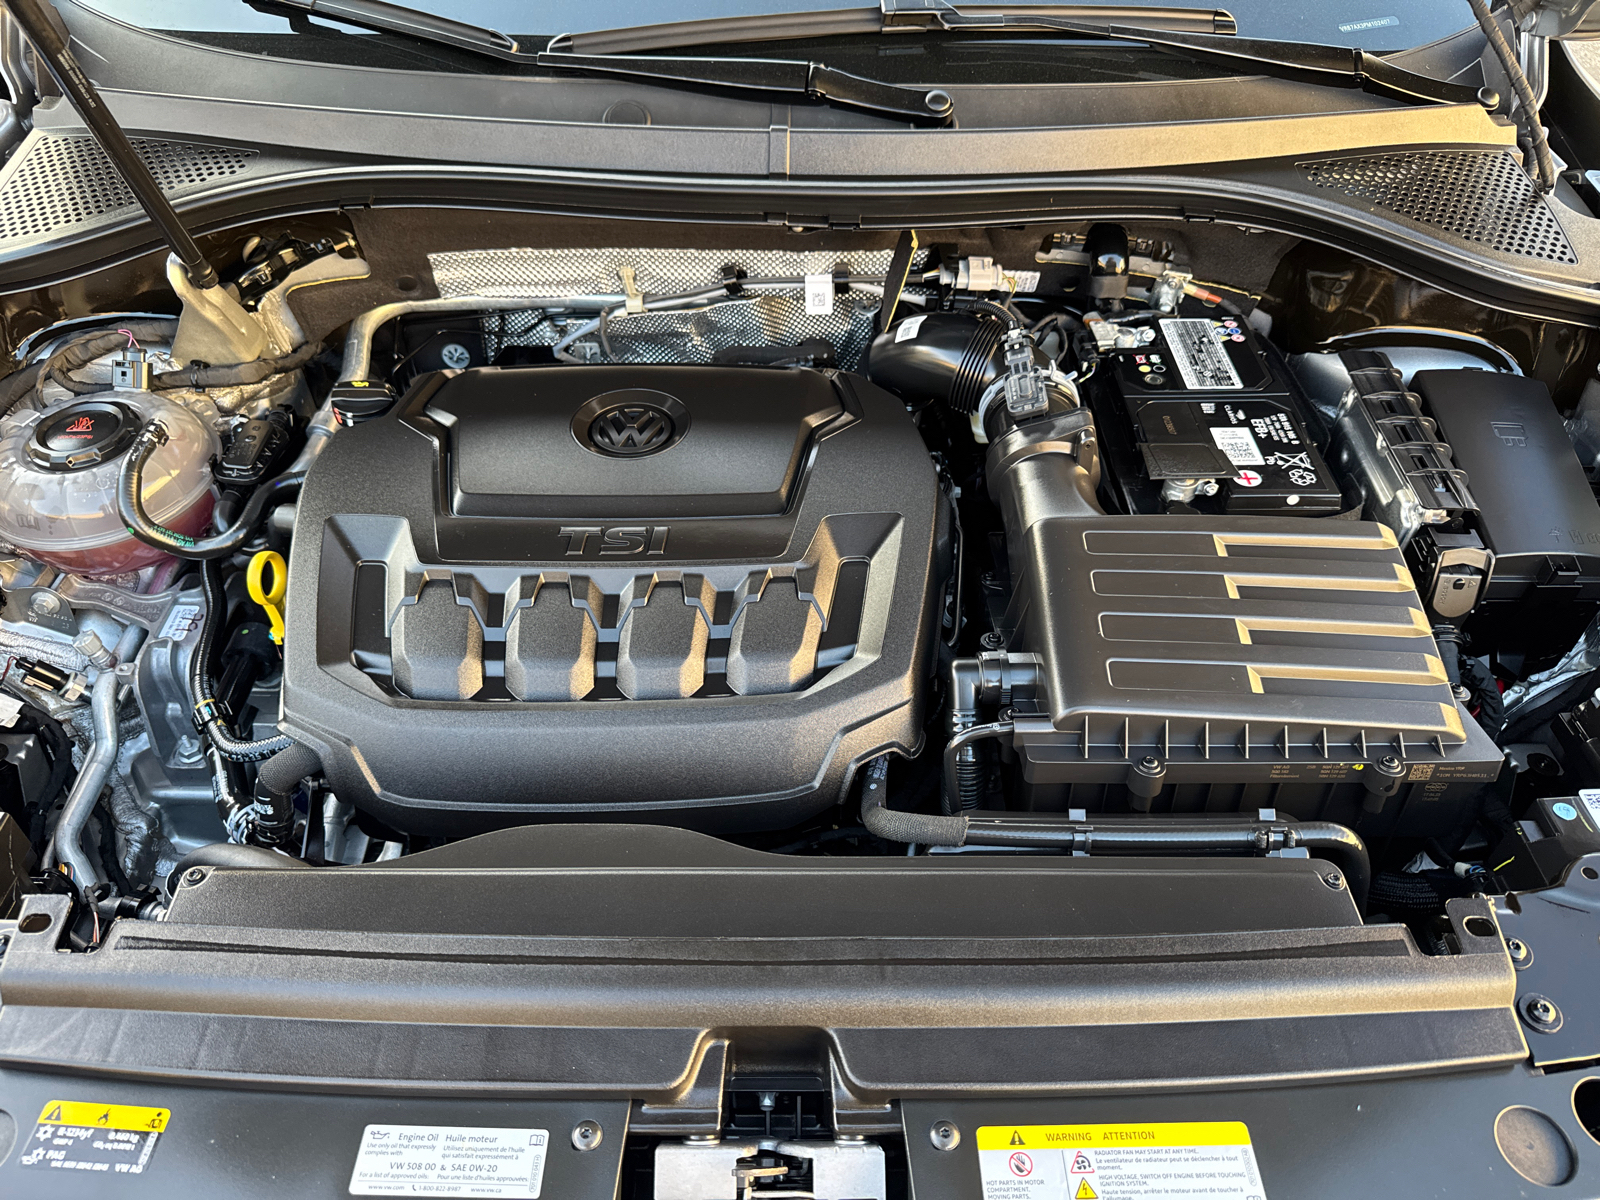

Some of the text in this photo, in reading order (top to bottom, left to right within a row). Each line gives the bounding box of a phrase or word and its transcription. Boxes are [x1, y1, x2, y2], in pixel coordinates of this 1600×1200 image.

[1224, 404, 1238, 424] CLARIOS
[1251, 418, 1269, 439] EFB+
[1264, 456, 1275, 465] Pb
[558, 526, 671, 556] TSI
[399, 1133, 425, 1143] Engine
[1046, 1131, 1155, 1141] WARNING ATTENTION
[45, 1150, 66, 1160] PAG
[115, 1163, 129, 1172] VW
[451, 1164, 467, 1172] SAE
